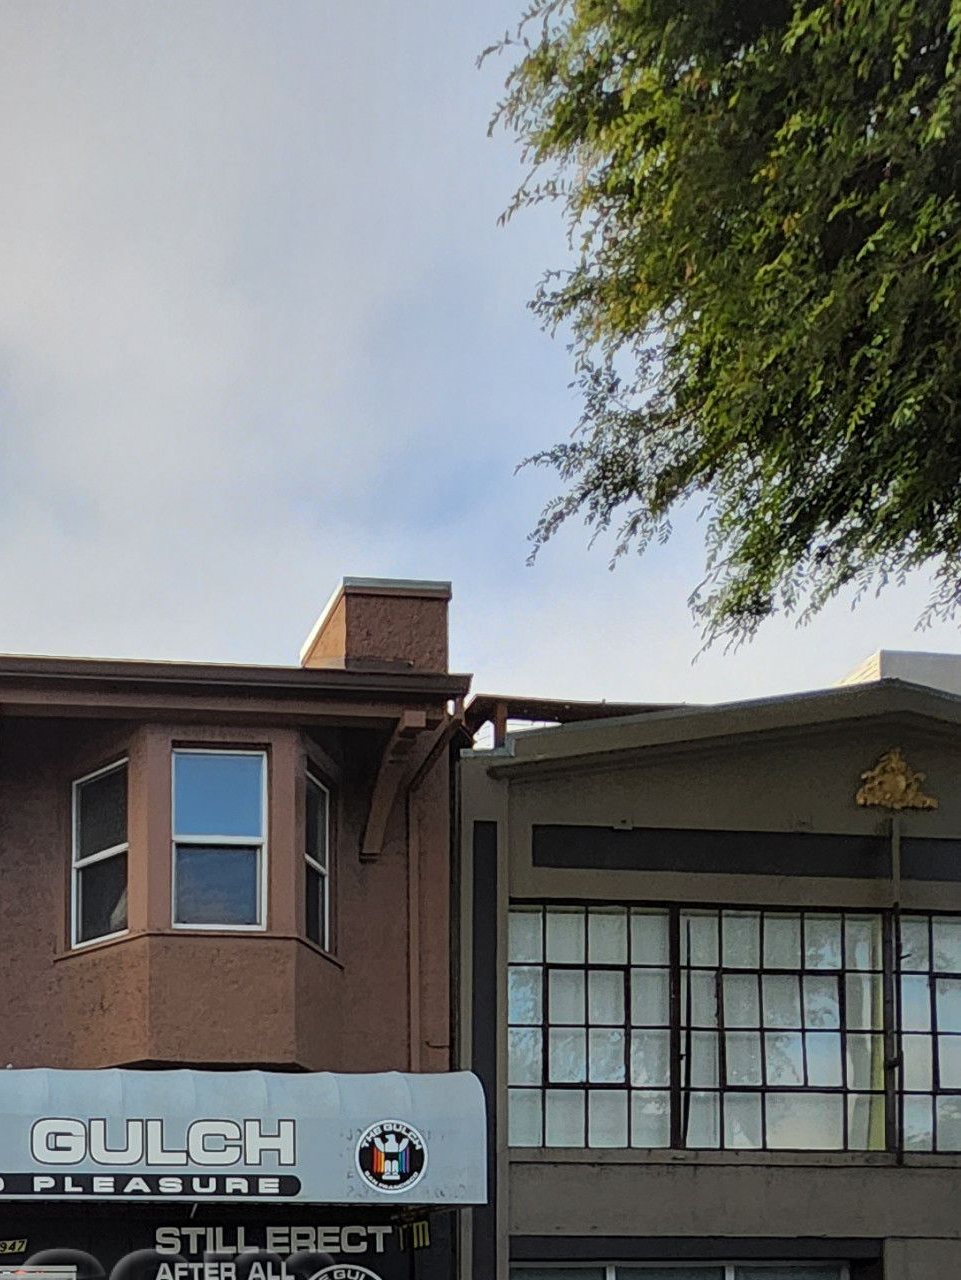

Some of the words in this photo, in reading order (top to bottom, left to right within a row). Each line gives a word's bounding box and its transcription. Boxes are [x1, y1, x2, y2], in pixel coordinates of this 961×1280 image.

[31, 1118, 296, 1167] GULCH
[361, 1126, 383, 1149] THE
[383, 1123, 423, 1150] GULCH
[33, 1176, 280, 1194] PLEASURE
[364, 1170, 379, 1185] SAN
[378, 1171, 419, 1190] FRANCISCO
[0, 1240, 25, 1253] 947
[155, 1226, 259, 1255] STILL
[266, 1225, 392, 1253] ERECT
